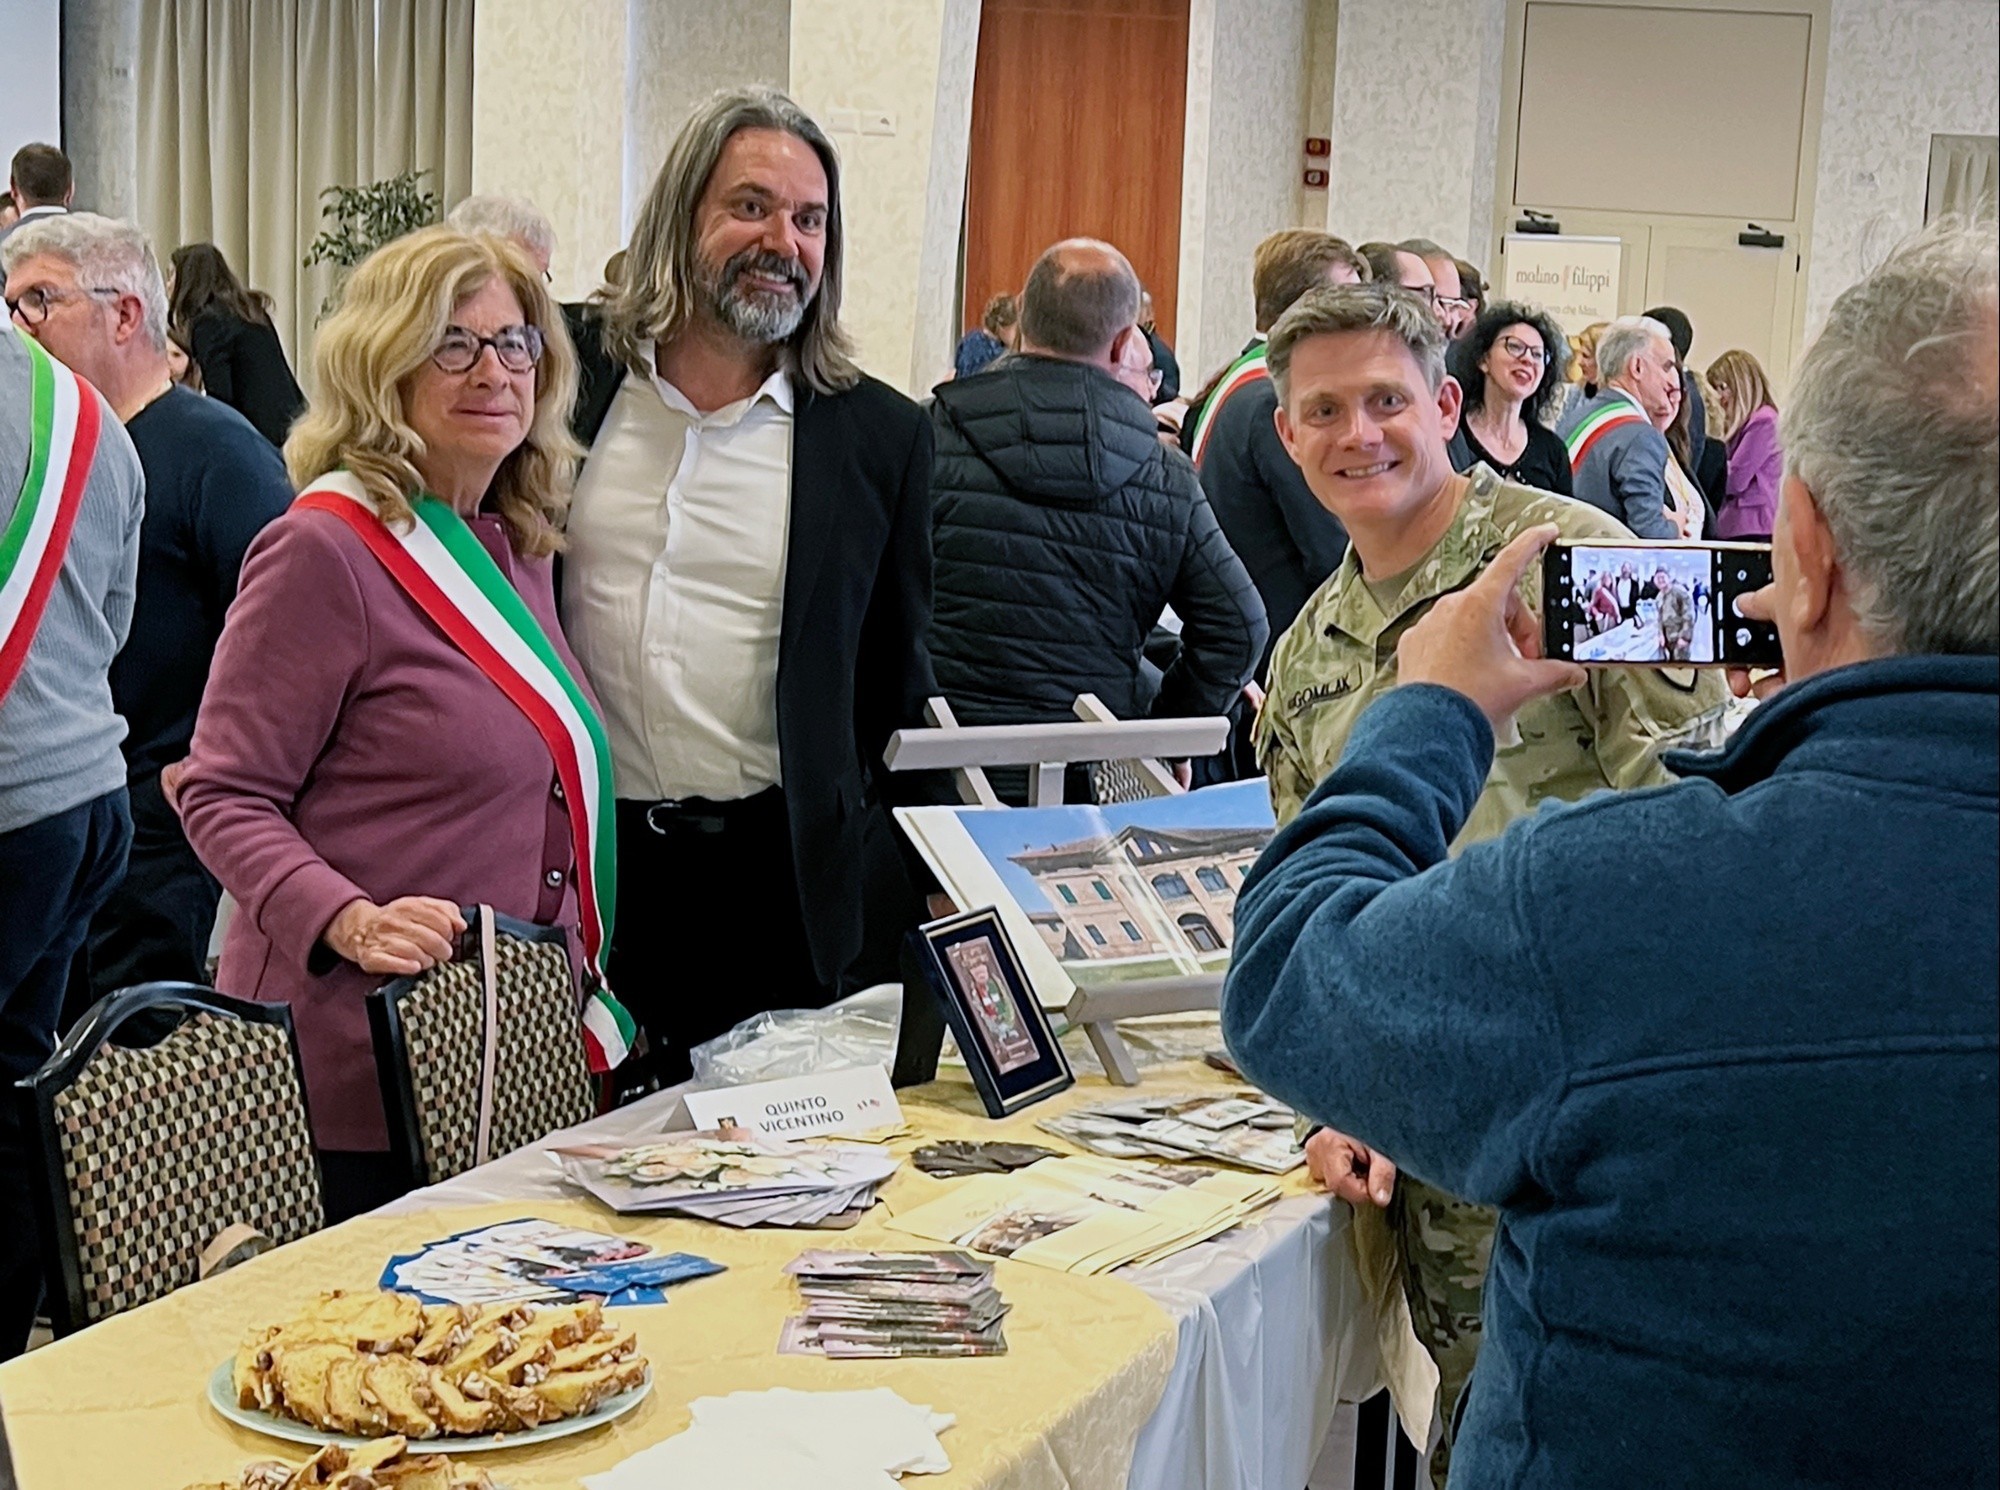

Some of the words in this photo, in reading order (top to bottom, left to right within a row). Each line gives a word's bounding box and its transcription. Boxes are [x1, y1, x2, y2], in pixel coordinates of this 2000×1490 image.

[1516, 264, 1559, 284] molino
[1572, 266, 1610, 292] filippi
[765, 1096, 827, 1116] QUINTO
[760, 1110, 843, 1132] VICENTINO
